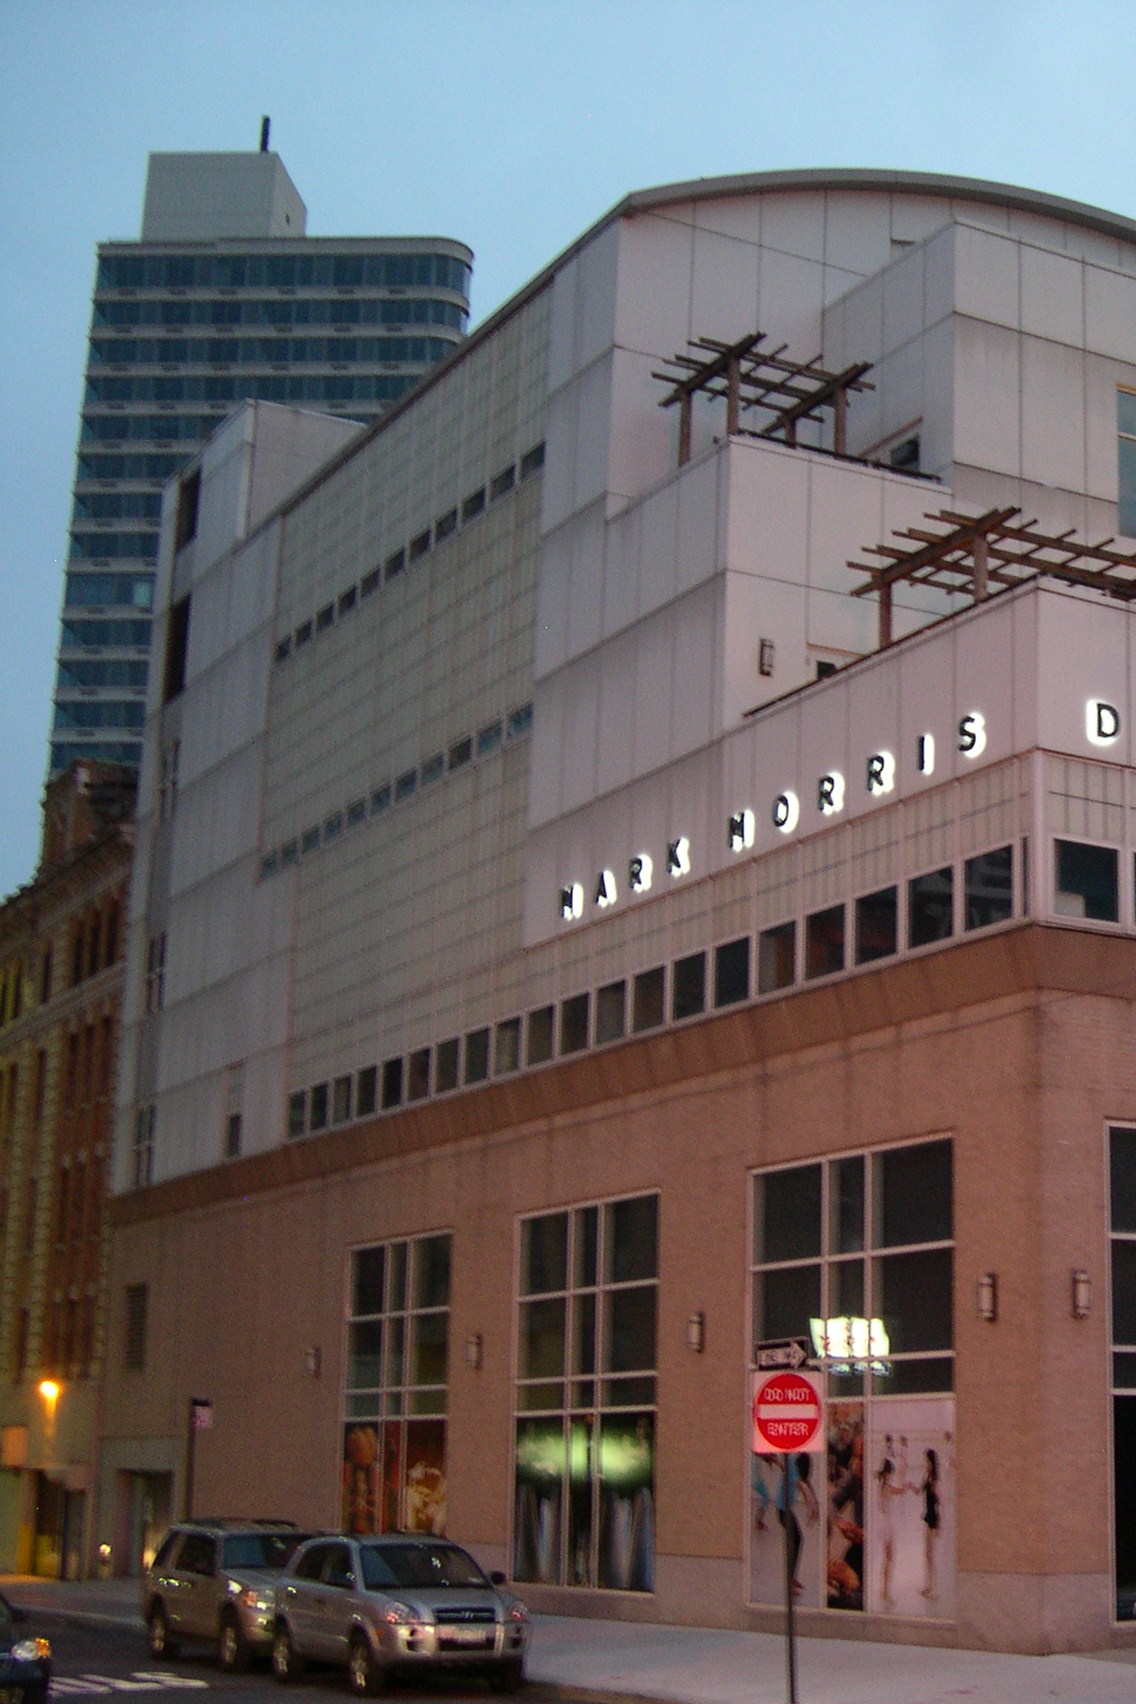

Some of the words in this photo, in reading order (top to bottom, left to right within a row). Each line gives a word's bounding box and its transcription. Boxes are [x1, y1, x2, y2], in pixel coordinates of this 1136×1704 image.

[558, 837, 690, 921] MARK
[728, 712, 986, 852] MORRIS
[767, 1422, 809, 1437] ENTER
